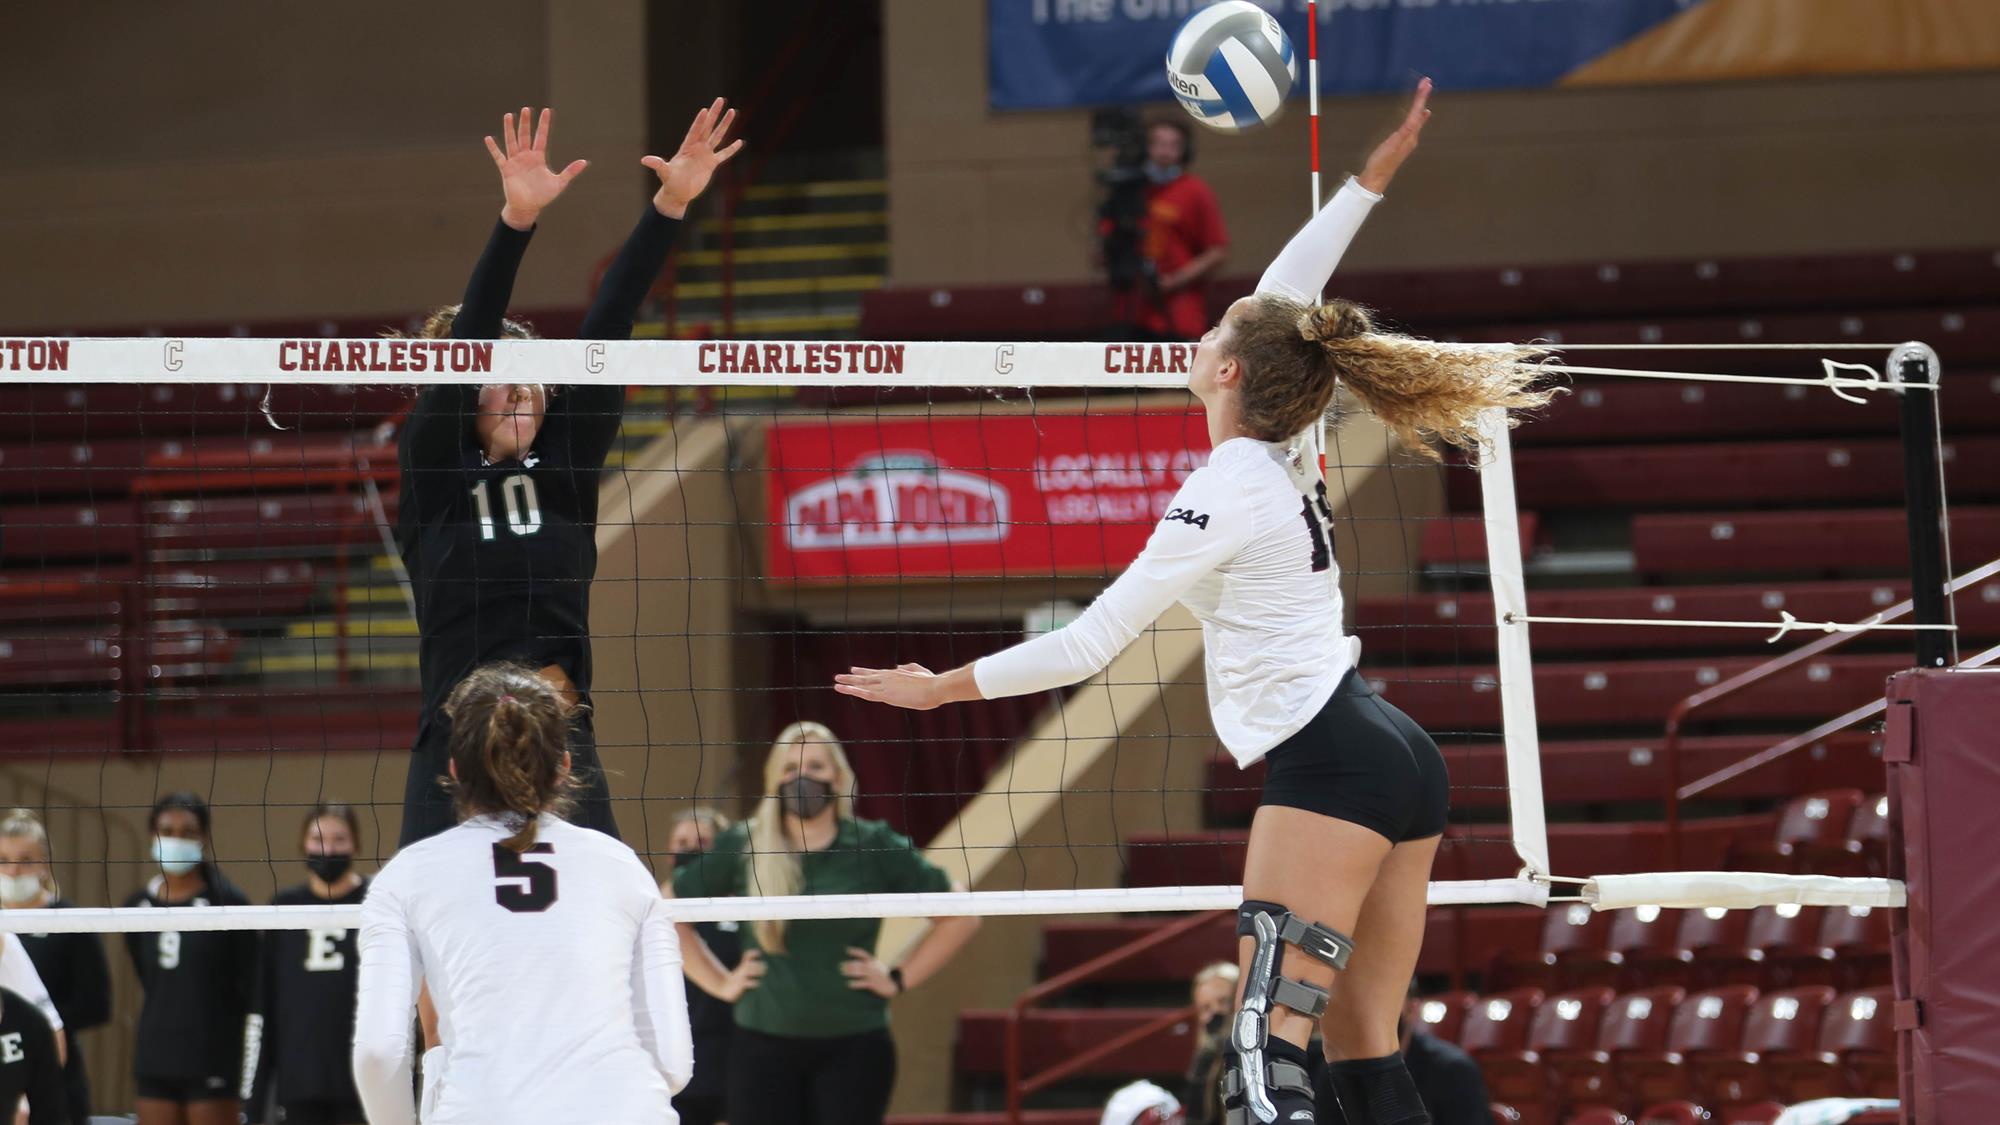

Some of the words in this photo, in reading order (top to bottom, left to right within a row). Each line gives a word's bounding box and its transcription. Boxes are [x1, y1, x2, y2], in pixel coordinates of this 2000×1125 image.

[278, 340, 493, 372] CHARLESTON
[698, 343, 905, 374] CHARLESTON
[471, 474, 542, 541] 10
[1165, 508, 1210, 530] CAA
[492, 842, 559, 913] 5
[159, 931, 181, 969] 9
[305, 928, 347, 971] E
[1, 1032, 25, 1064] E
